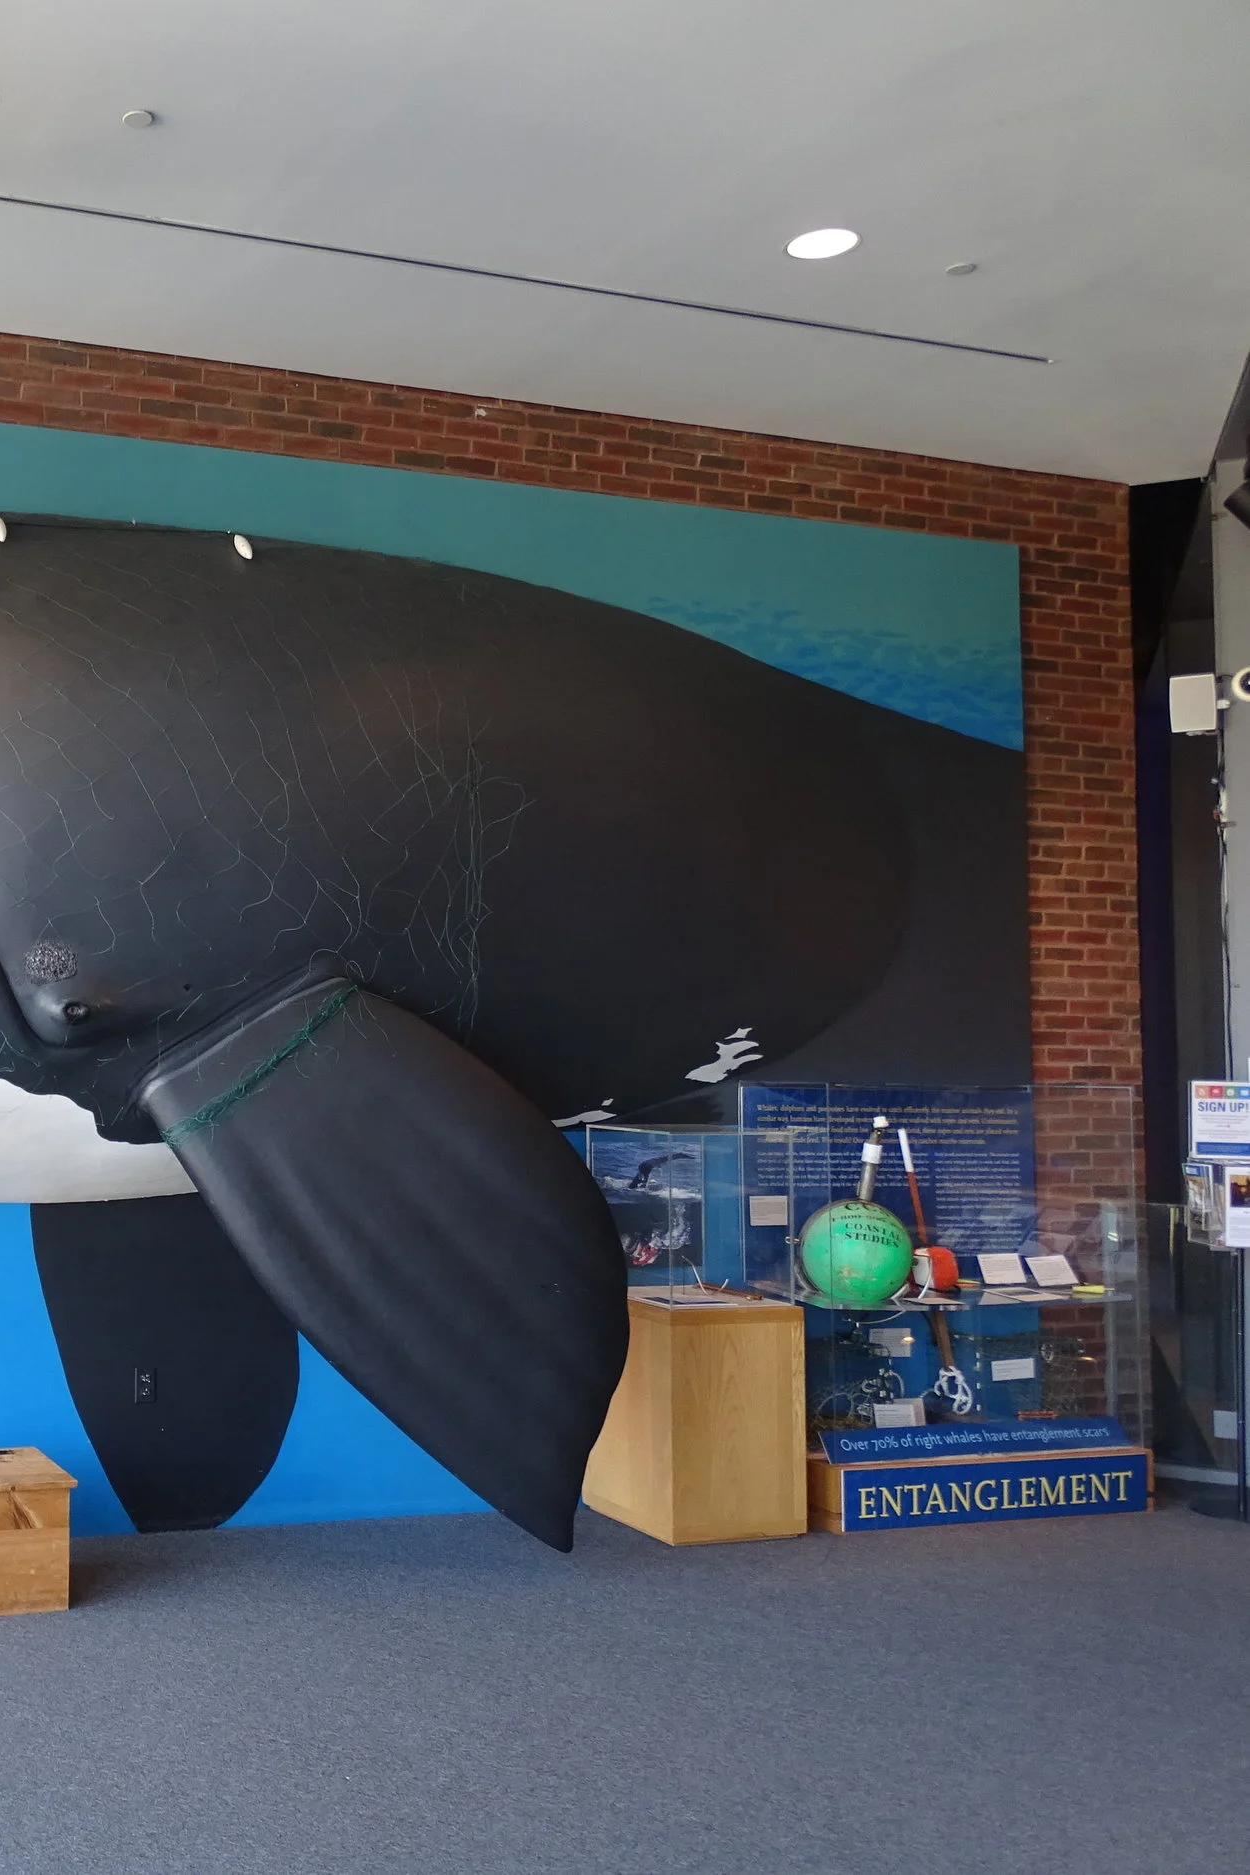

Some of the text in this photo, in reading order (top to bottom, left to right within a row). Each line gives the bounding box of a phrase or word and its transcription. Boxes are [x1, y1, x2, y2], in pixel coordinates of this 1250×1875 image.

[1197, 1101, 1249, 1114] SIGN UP!
[845, 1231, 900, 1249] STUDIES
[840, 1422, 1110, 1452] Over 70% of right whales have entanglement scars
[858, 1470, 1133, 1520] ENTANGLEMENT
